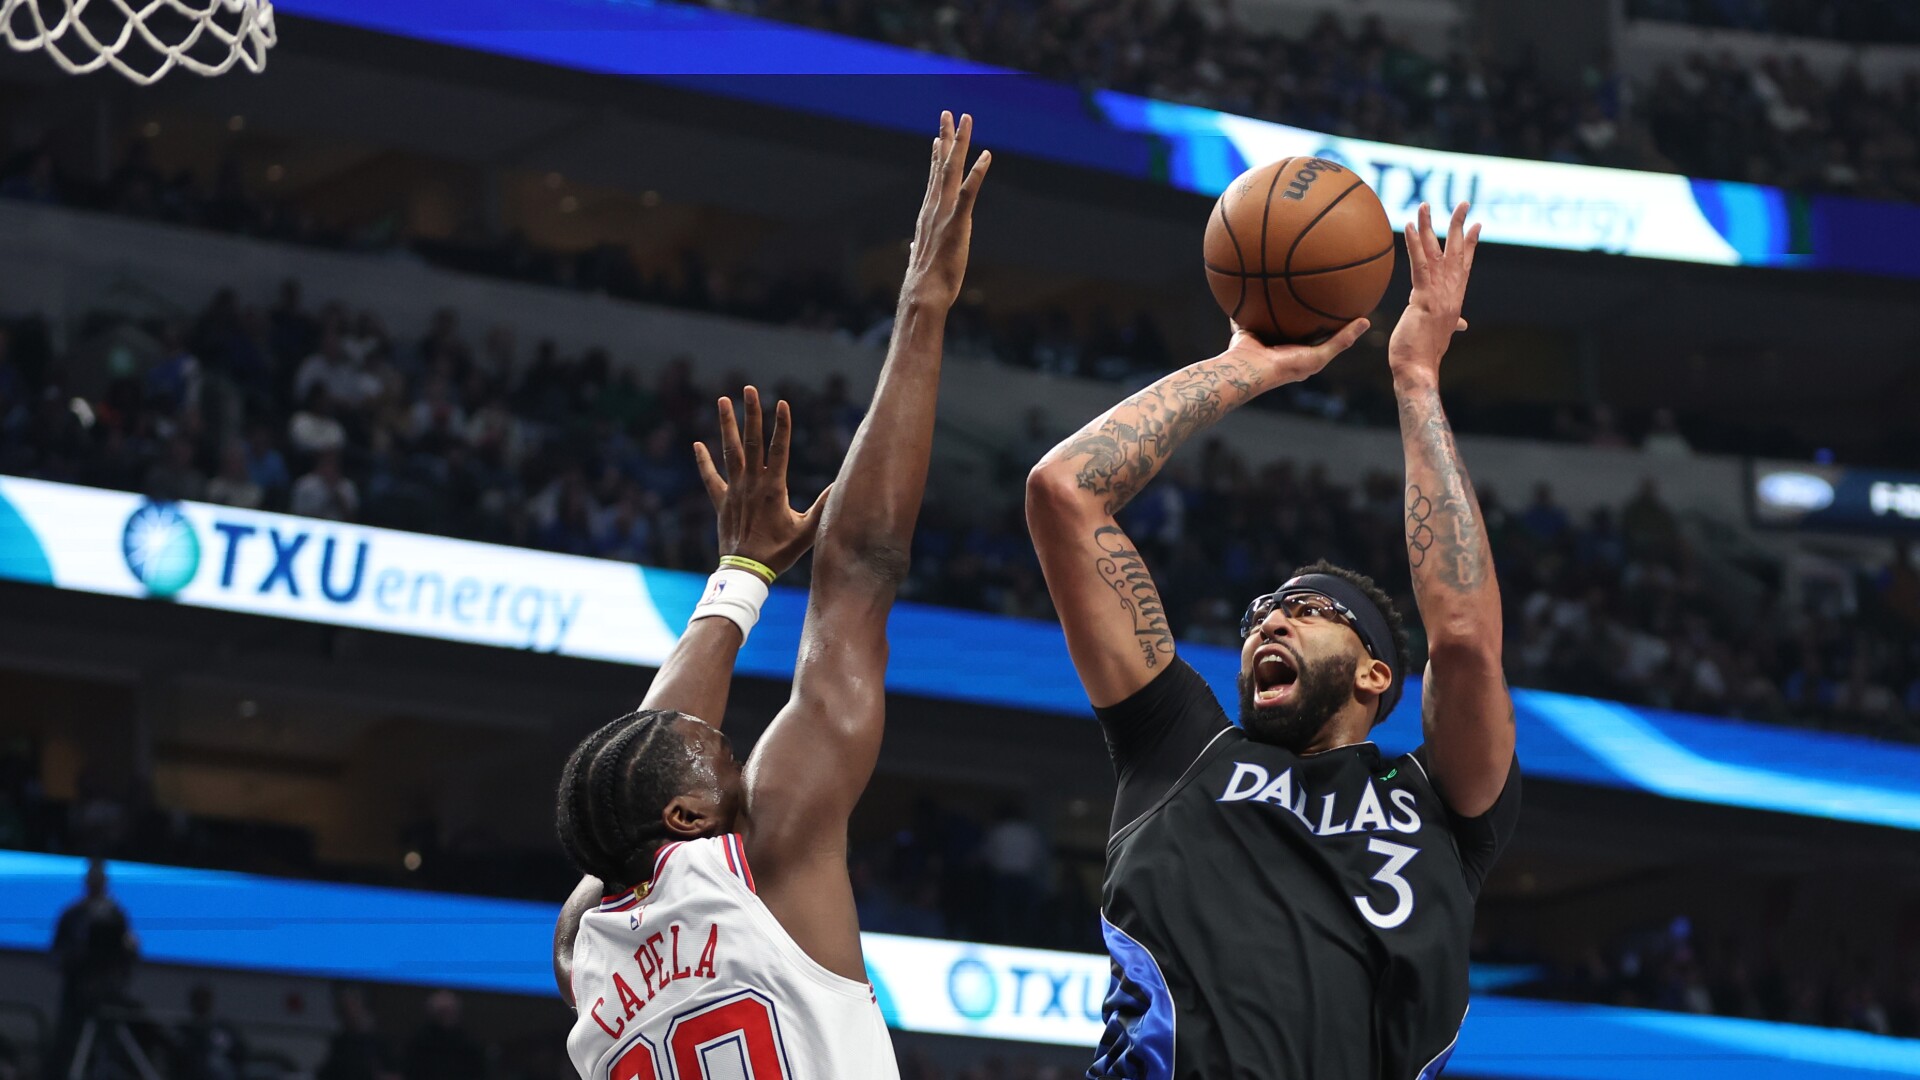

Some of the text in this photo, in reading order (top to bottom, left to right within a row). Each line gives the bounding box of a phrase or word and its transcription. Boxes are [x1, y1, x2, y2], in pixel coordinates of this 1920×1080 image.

[1282, 157, 1343, 201] lson
[1216, 761, 1422, 836] DALLAS
[1353, 836, 1421, 930] 3
[590, 923, 718, 1040] CAPELA
